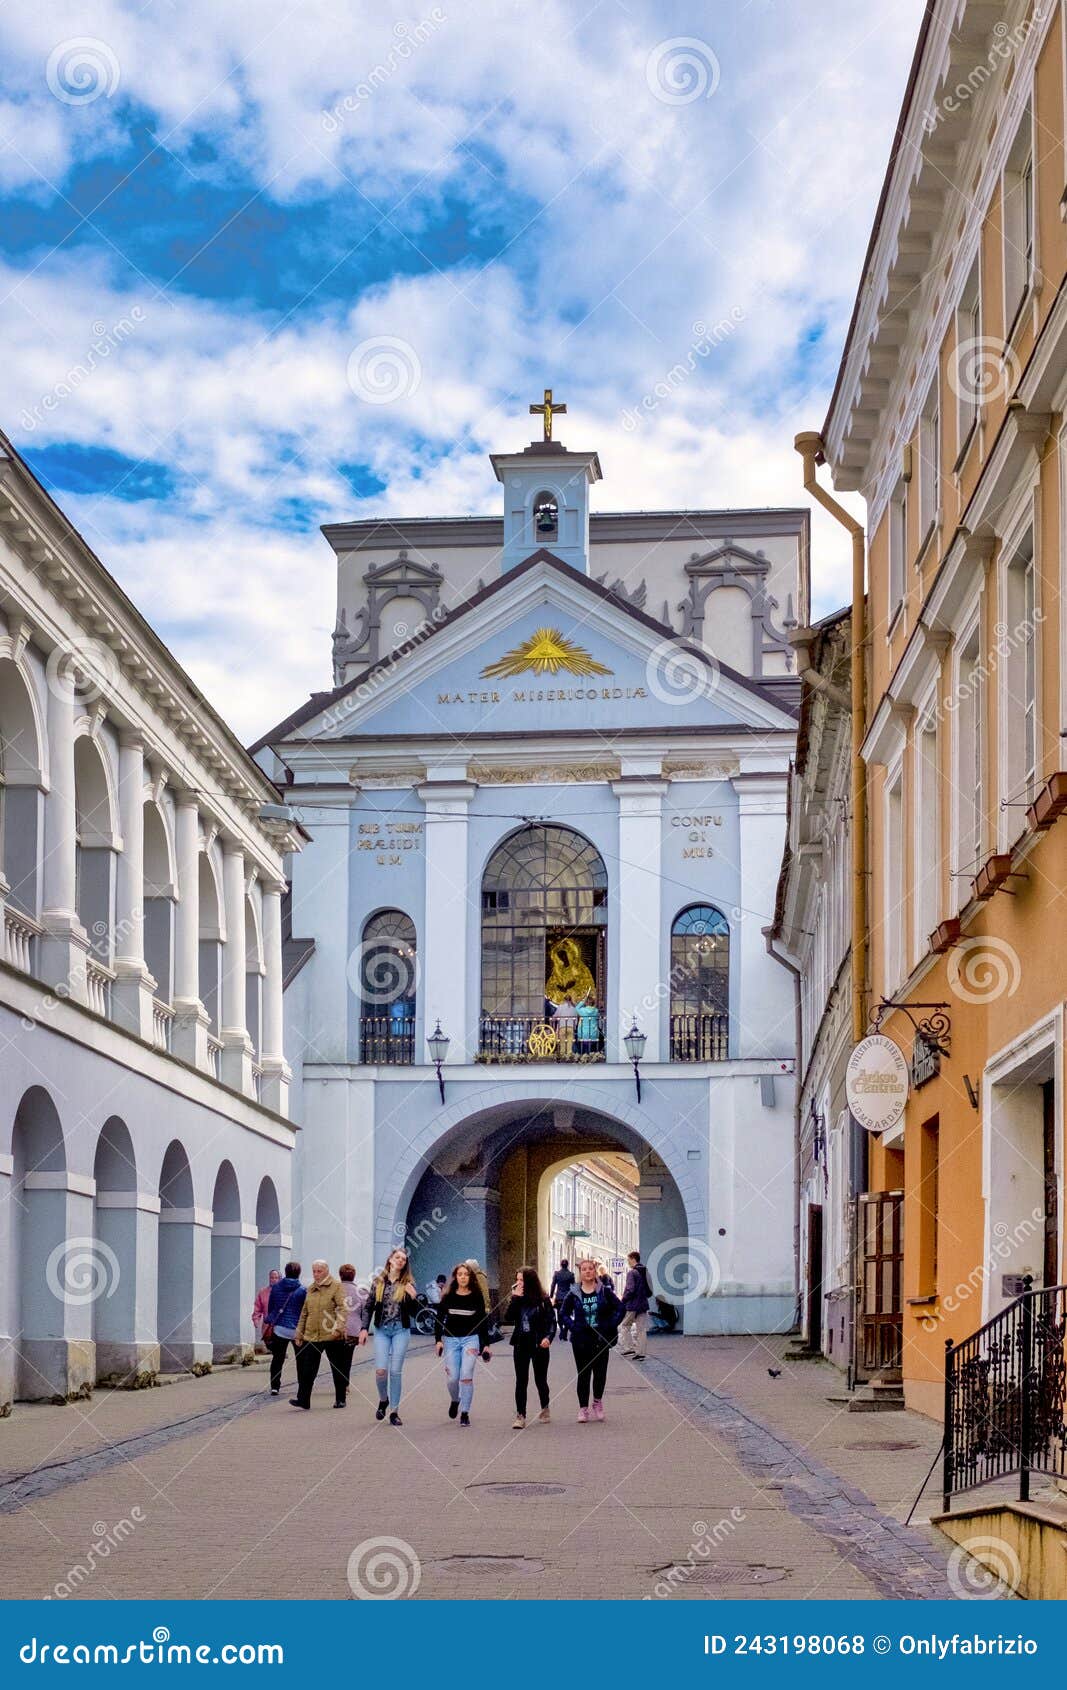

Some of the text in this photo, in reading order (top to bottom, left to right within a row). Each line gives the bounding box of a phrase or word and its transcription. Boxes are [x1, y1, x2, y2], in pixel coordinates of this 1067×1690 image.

[437, 691, 501, 705] MATER
[670, 815, 723, 828] CONFU
[358, 823, 380, 834] SUB
[688, 831, 706, 842] GI
[682, 847, 714, 859] MUS
[376, 854, 402, 866] UM
[851, 1101, 903, 1128] LOMBARDAS
